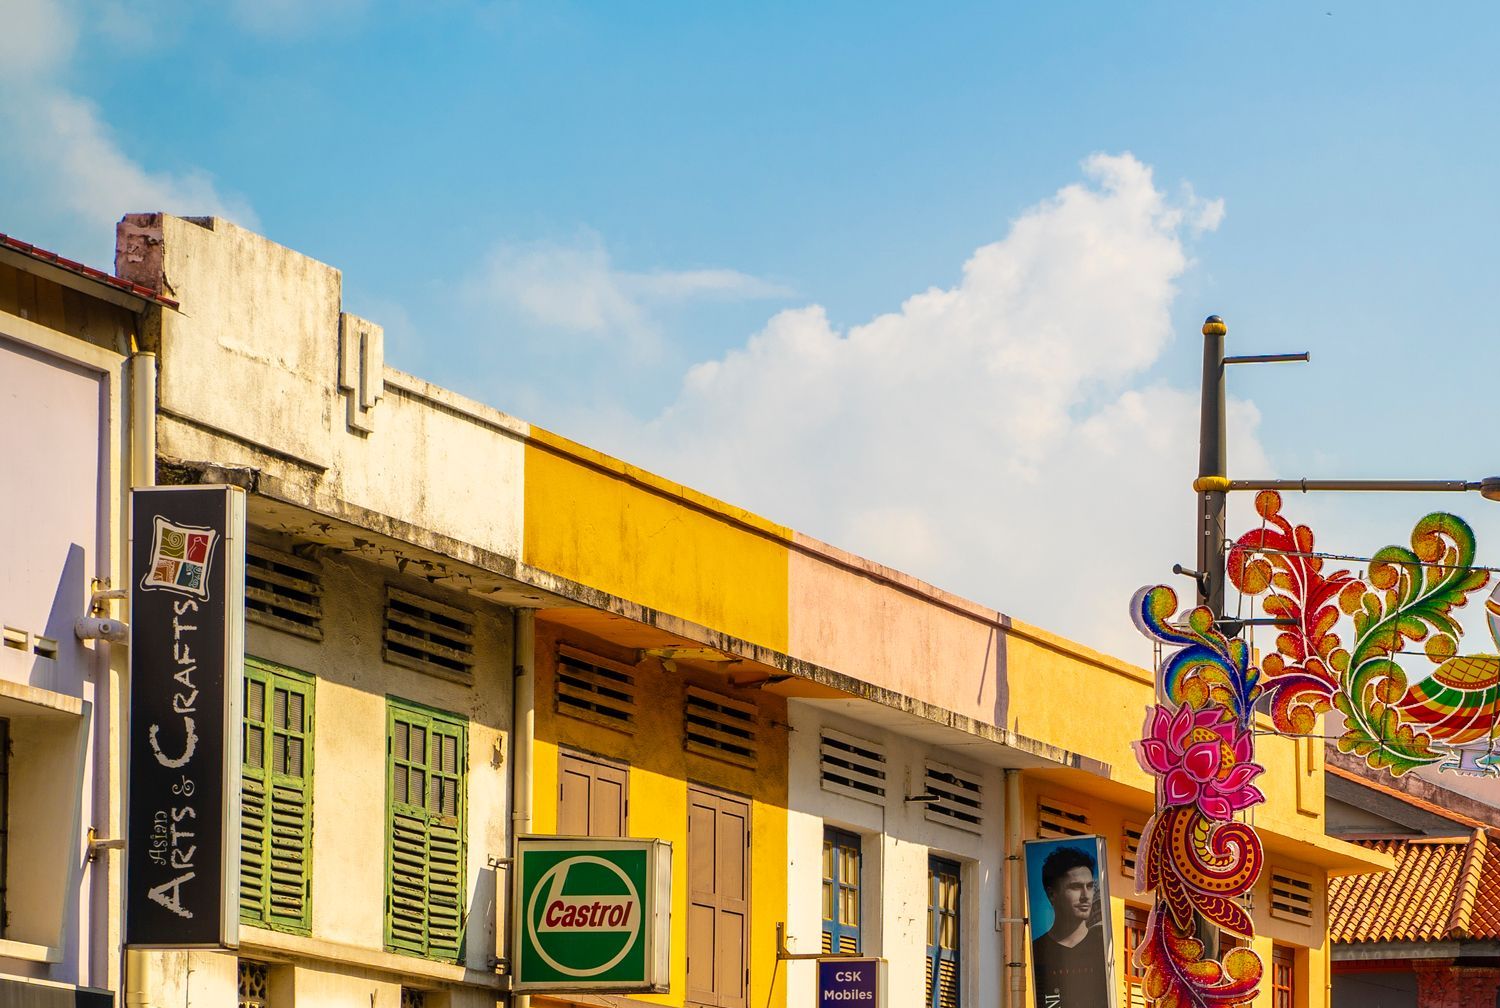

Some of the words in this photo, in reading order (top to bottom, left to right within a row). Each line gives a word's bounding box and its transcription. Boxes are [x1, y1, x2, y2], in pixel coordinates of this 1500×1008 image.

[149, 599, 198, 768] CRAFTS
[173, 776, 195, 798] &
[149, 810, 167, 865] Asian
[148, 806, 196, 919] ARTS
[545, 899, 633, 929] Castrol
[835, 971, 862, 982] CSK
[824, 989, 872, 1000] Mobiles
